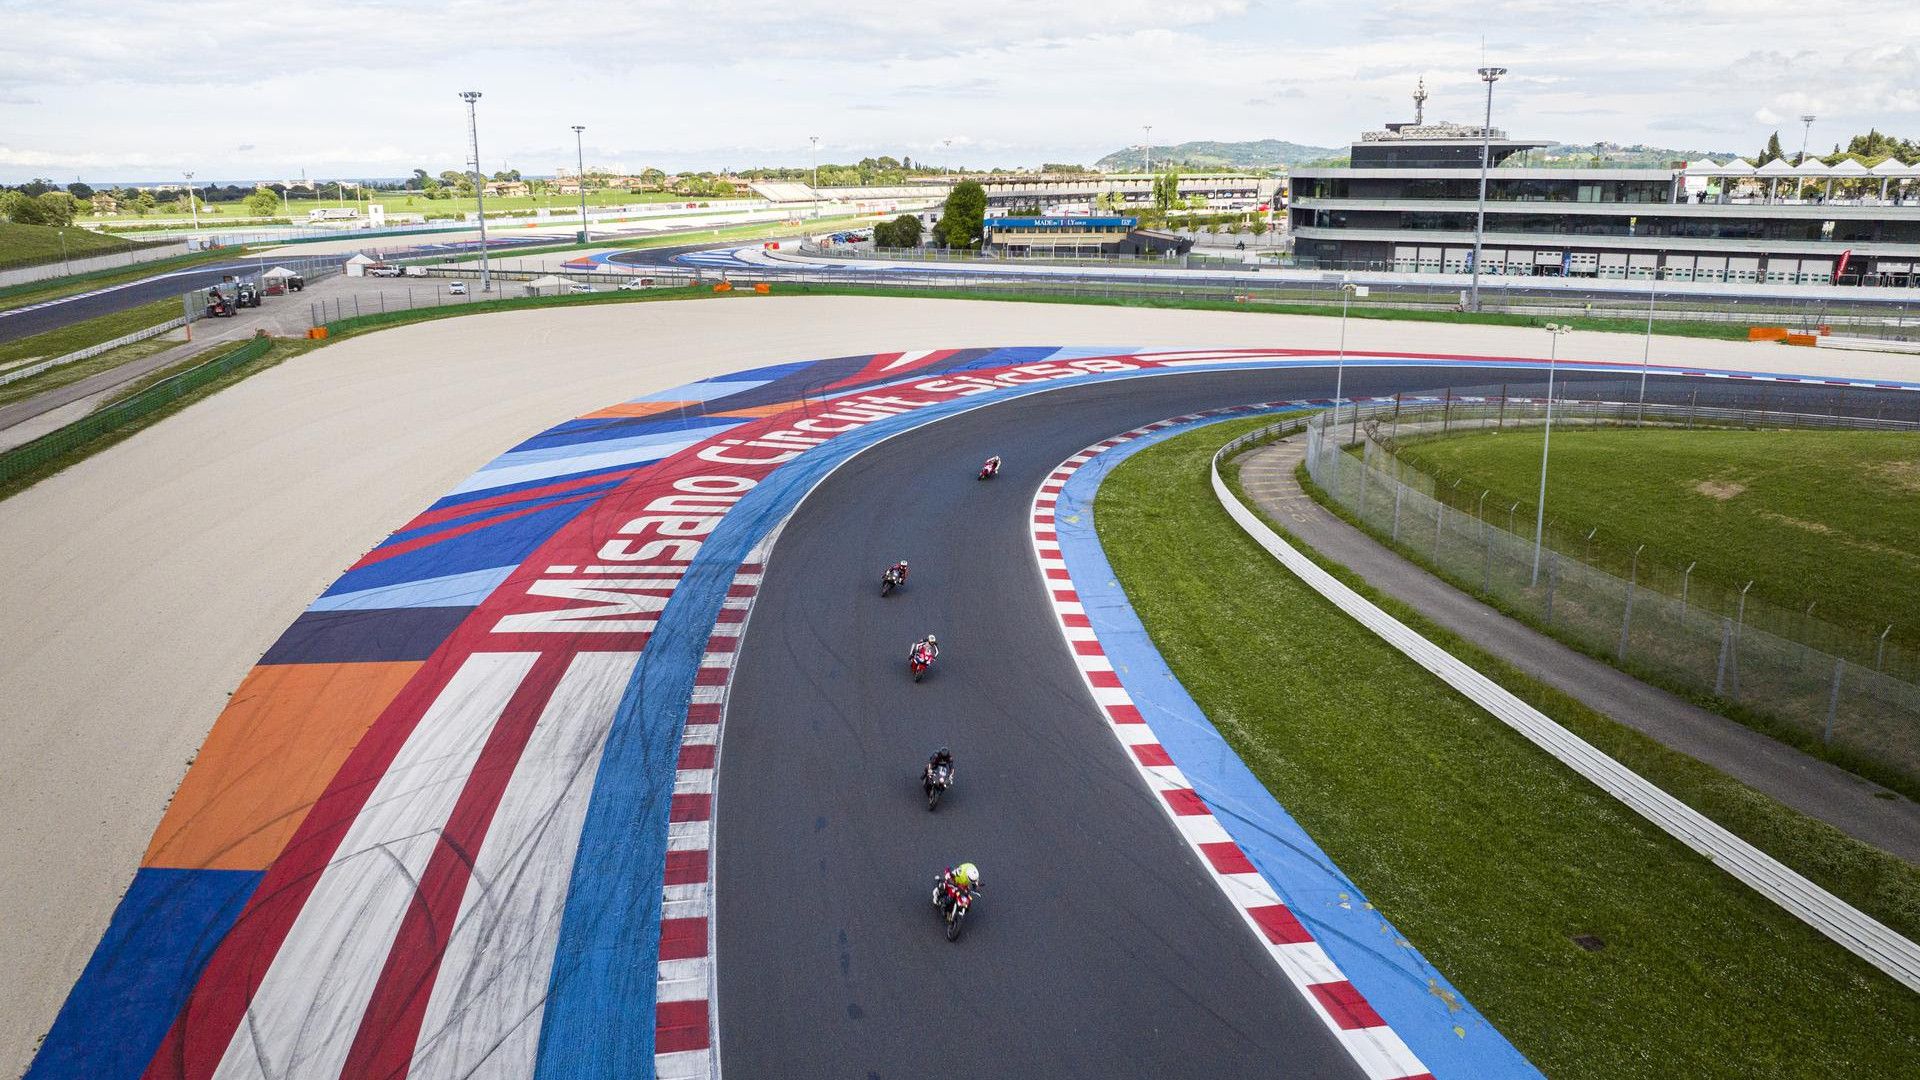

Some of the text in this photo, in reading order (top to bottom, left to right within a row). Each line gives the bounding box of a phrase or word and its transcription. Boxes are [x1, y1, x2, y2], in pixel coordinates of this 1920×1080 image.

[489, 359, 1141, 633] Misano Circuit Sic58
